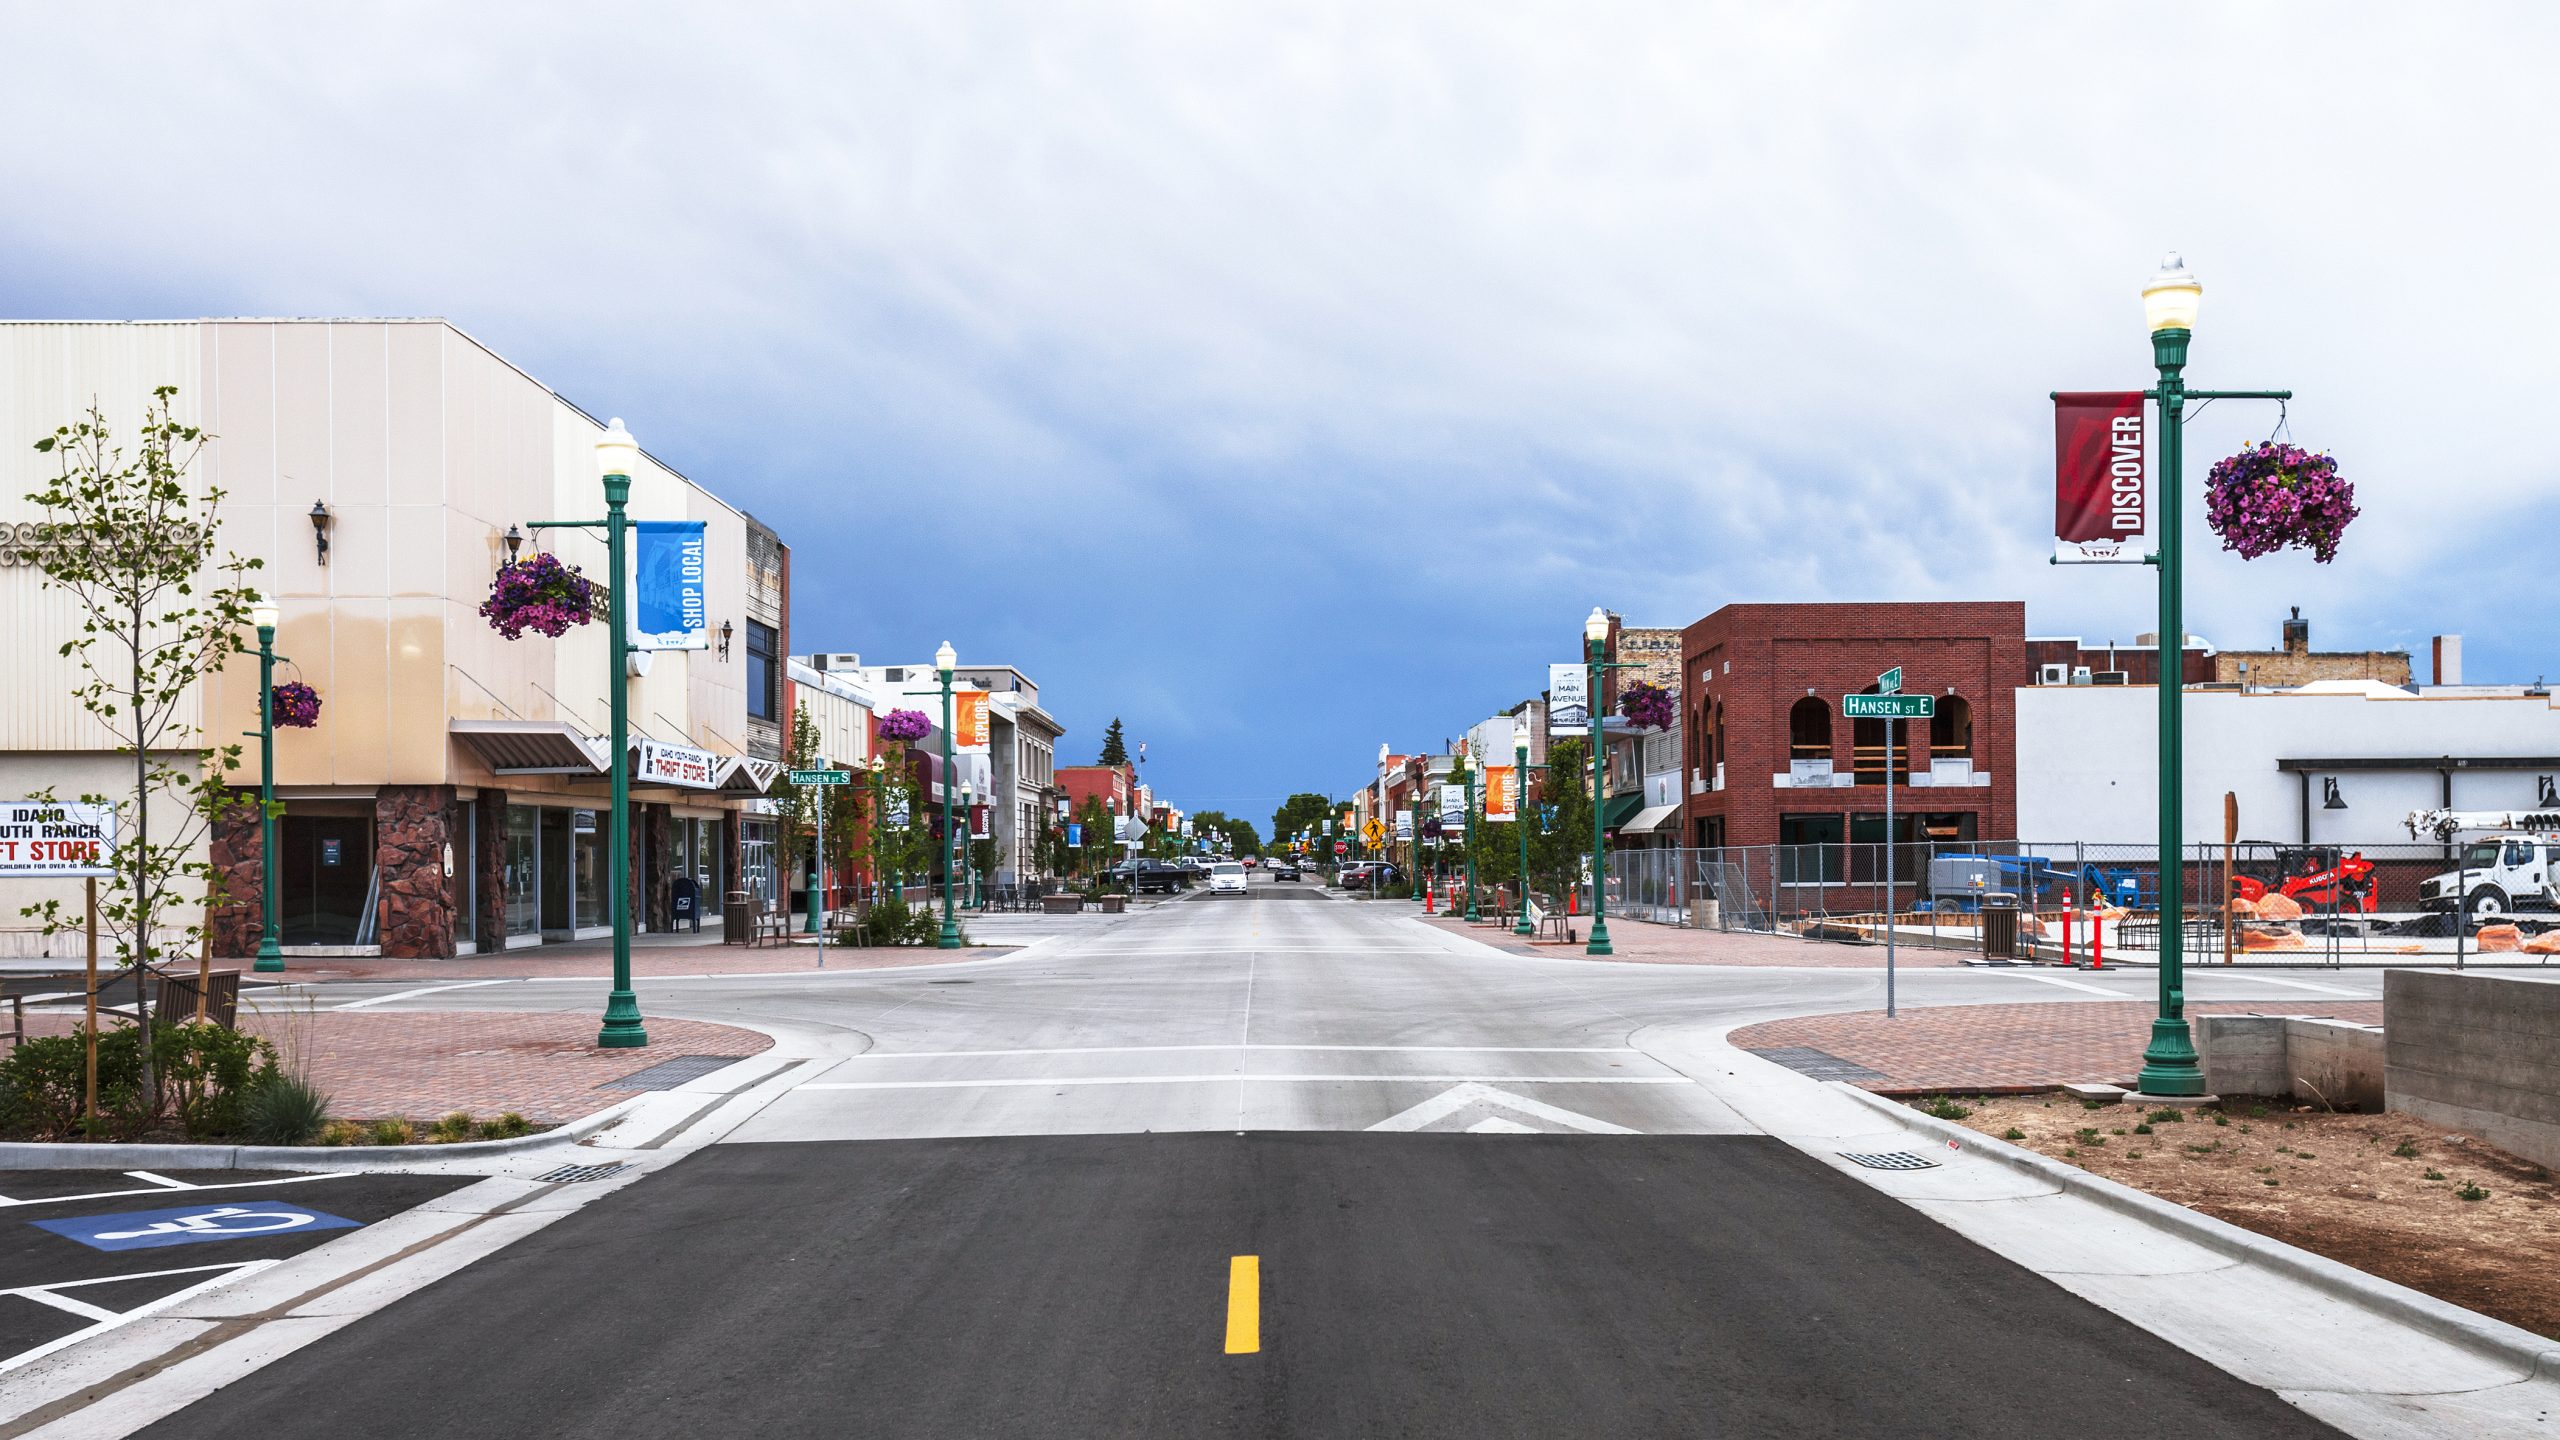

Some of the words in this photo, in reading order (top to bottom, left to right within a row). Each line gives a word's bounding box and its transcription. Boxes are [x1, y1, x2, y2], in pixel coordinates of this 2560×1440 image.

[2111, 416, 2142, 530] DISCOVER
[682, 538, 702, 583] LOCAL
[682, 587, 702, 628] SHOP
[1551, 695, 1587, 703] AVENUE
[1849, 698, 1900, 714] HANSEN
[1905, 705, 1915, 714] ST
[1920, 698, 1929, 714] E
[974, 700, 989, 743] EXPLORE
[660, 748, 674, 759] IDAHO
[675, 751, 688, 761] YOUTH
[688, 753, 702, 763] RANCH
[655, 758, 680, 778] THRIFT
[683, 763, 706, 782] STORE
[791, 772, 830, 783] HANSEN
[841, 772, 849, 783] S
[1502, 774, 1515, 811] EXPLORE
[41, 825, 100, 838] RANCH
[981, 809, 989, 833] DISCOVER
[30, 841, 100, 861] STORE
[2309, 871, 2335, 885] KUBOA
